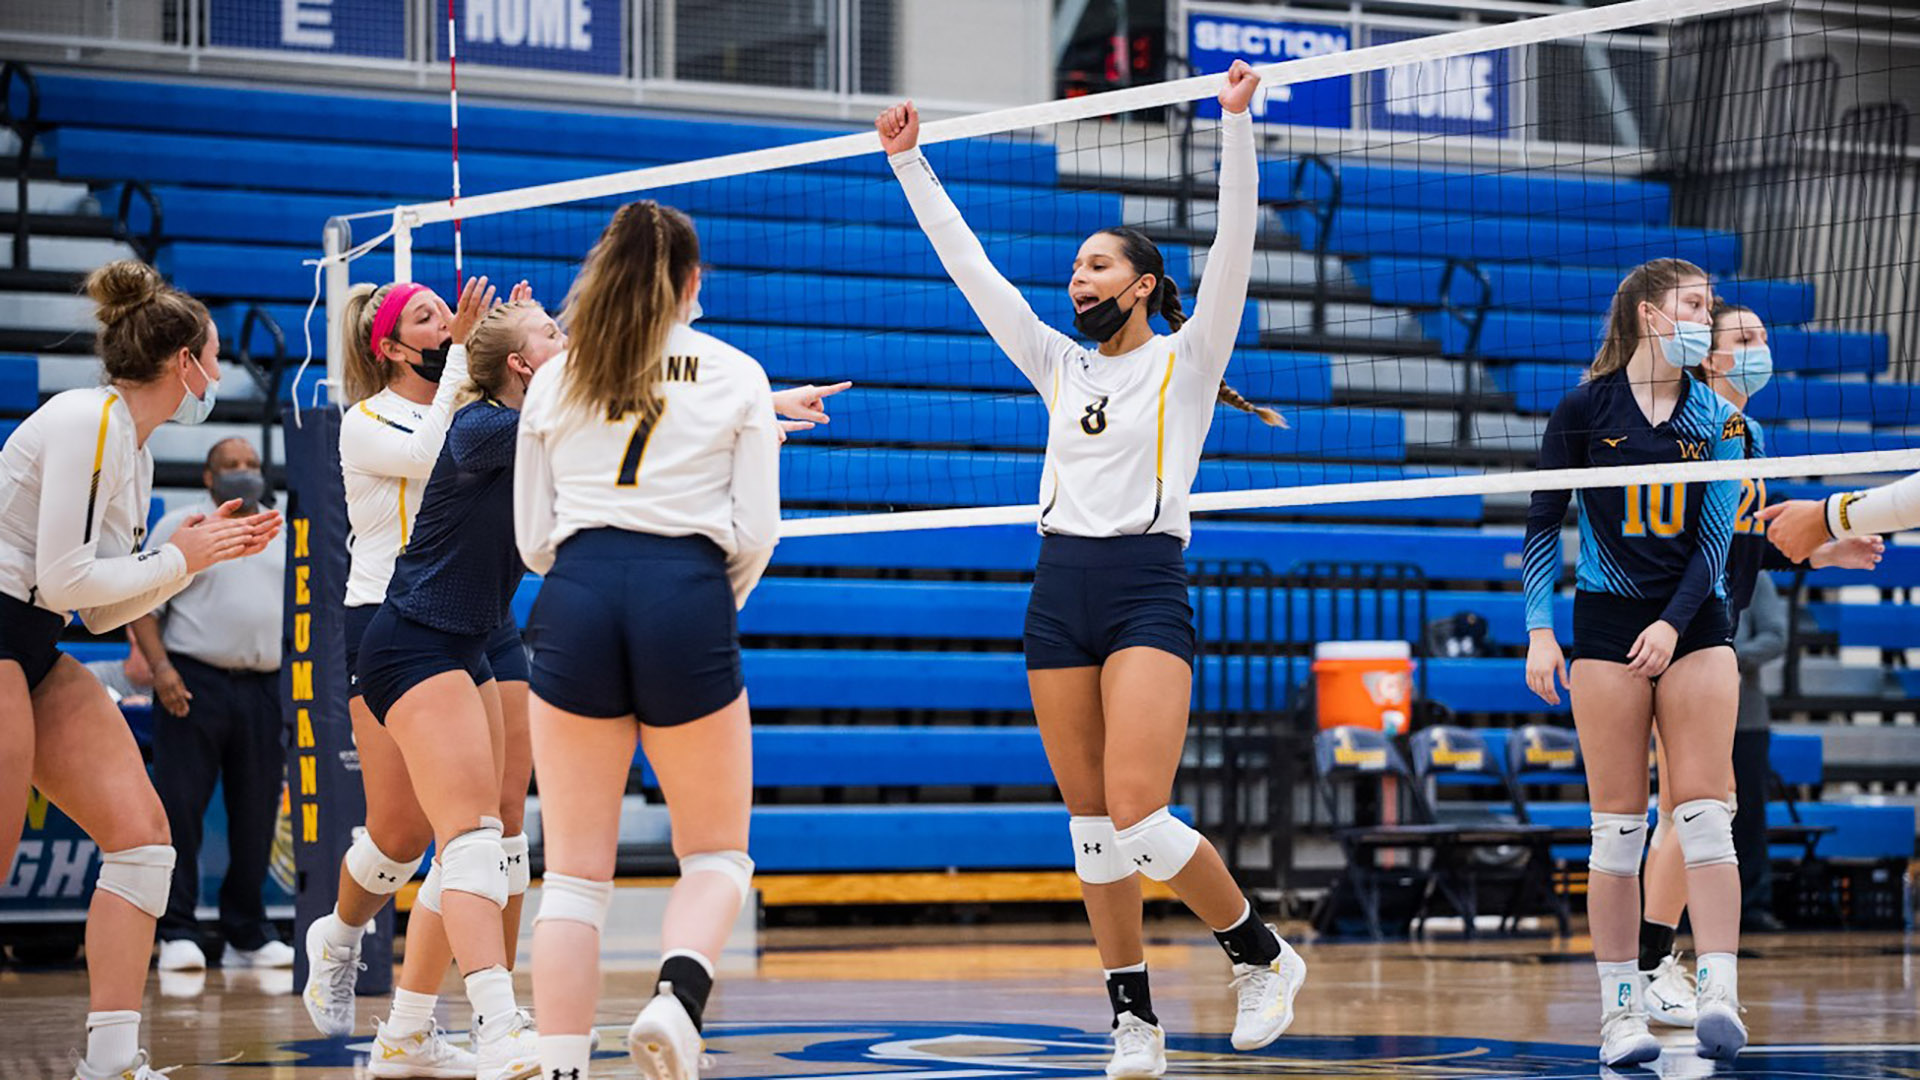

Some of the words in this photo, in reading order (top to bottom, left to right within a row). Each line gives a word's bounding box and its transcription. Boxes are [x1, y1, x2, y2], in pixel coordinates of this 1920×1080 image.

[465, 0, 592, 50] HOME
[1194, 21, 1347, 56] SECTION
[1384, 55, 1493, 120] HOME
[605, 396, 667, 489] 7
[1080, 396, 1108, 435] 8
[1621, 483, 1686, 538] 10
[292, 518, 318, 842] NEUMANN
[0, 840, 104, 897] GH
